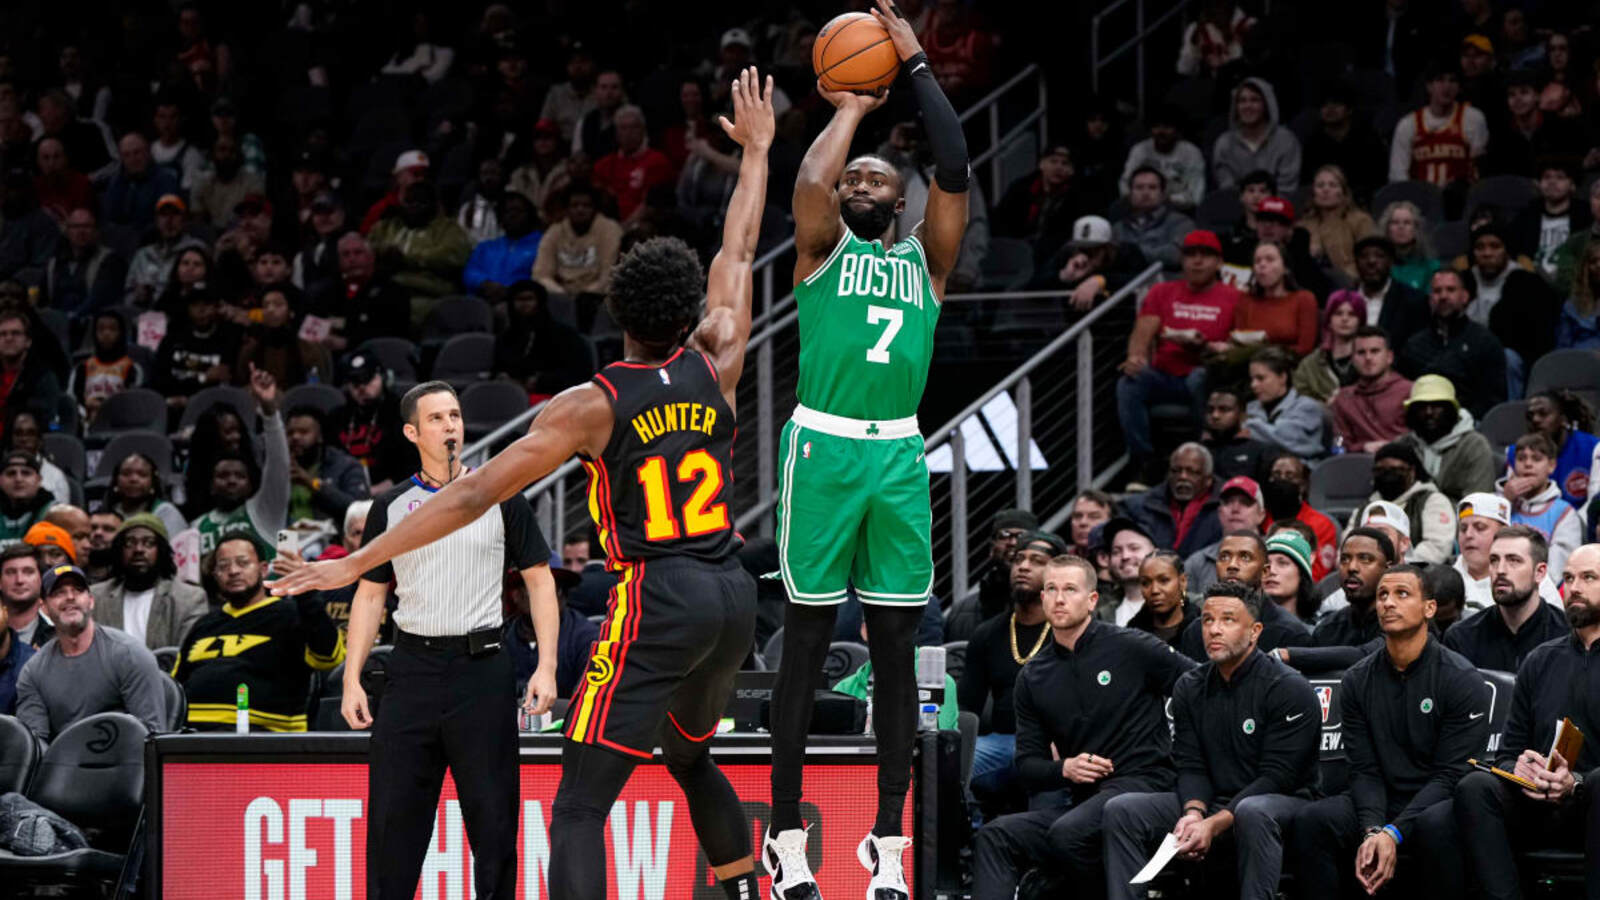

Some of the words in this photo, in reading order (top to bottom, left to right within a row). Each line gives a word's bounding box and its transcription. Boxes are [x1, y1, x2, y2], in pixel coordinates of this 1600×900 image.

[837, 253, 923, 310] BOSTON
[866, 304, 904, 364] 7
[631, 402, 717, 444] HUNTER
[636, 447, 731, 541] 12
[244, 796, 363, 900] GET
